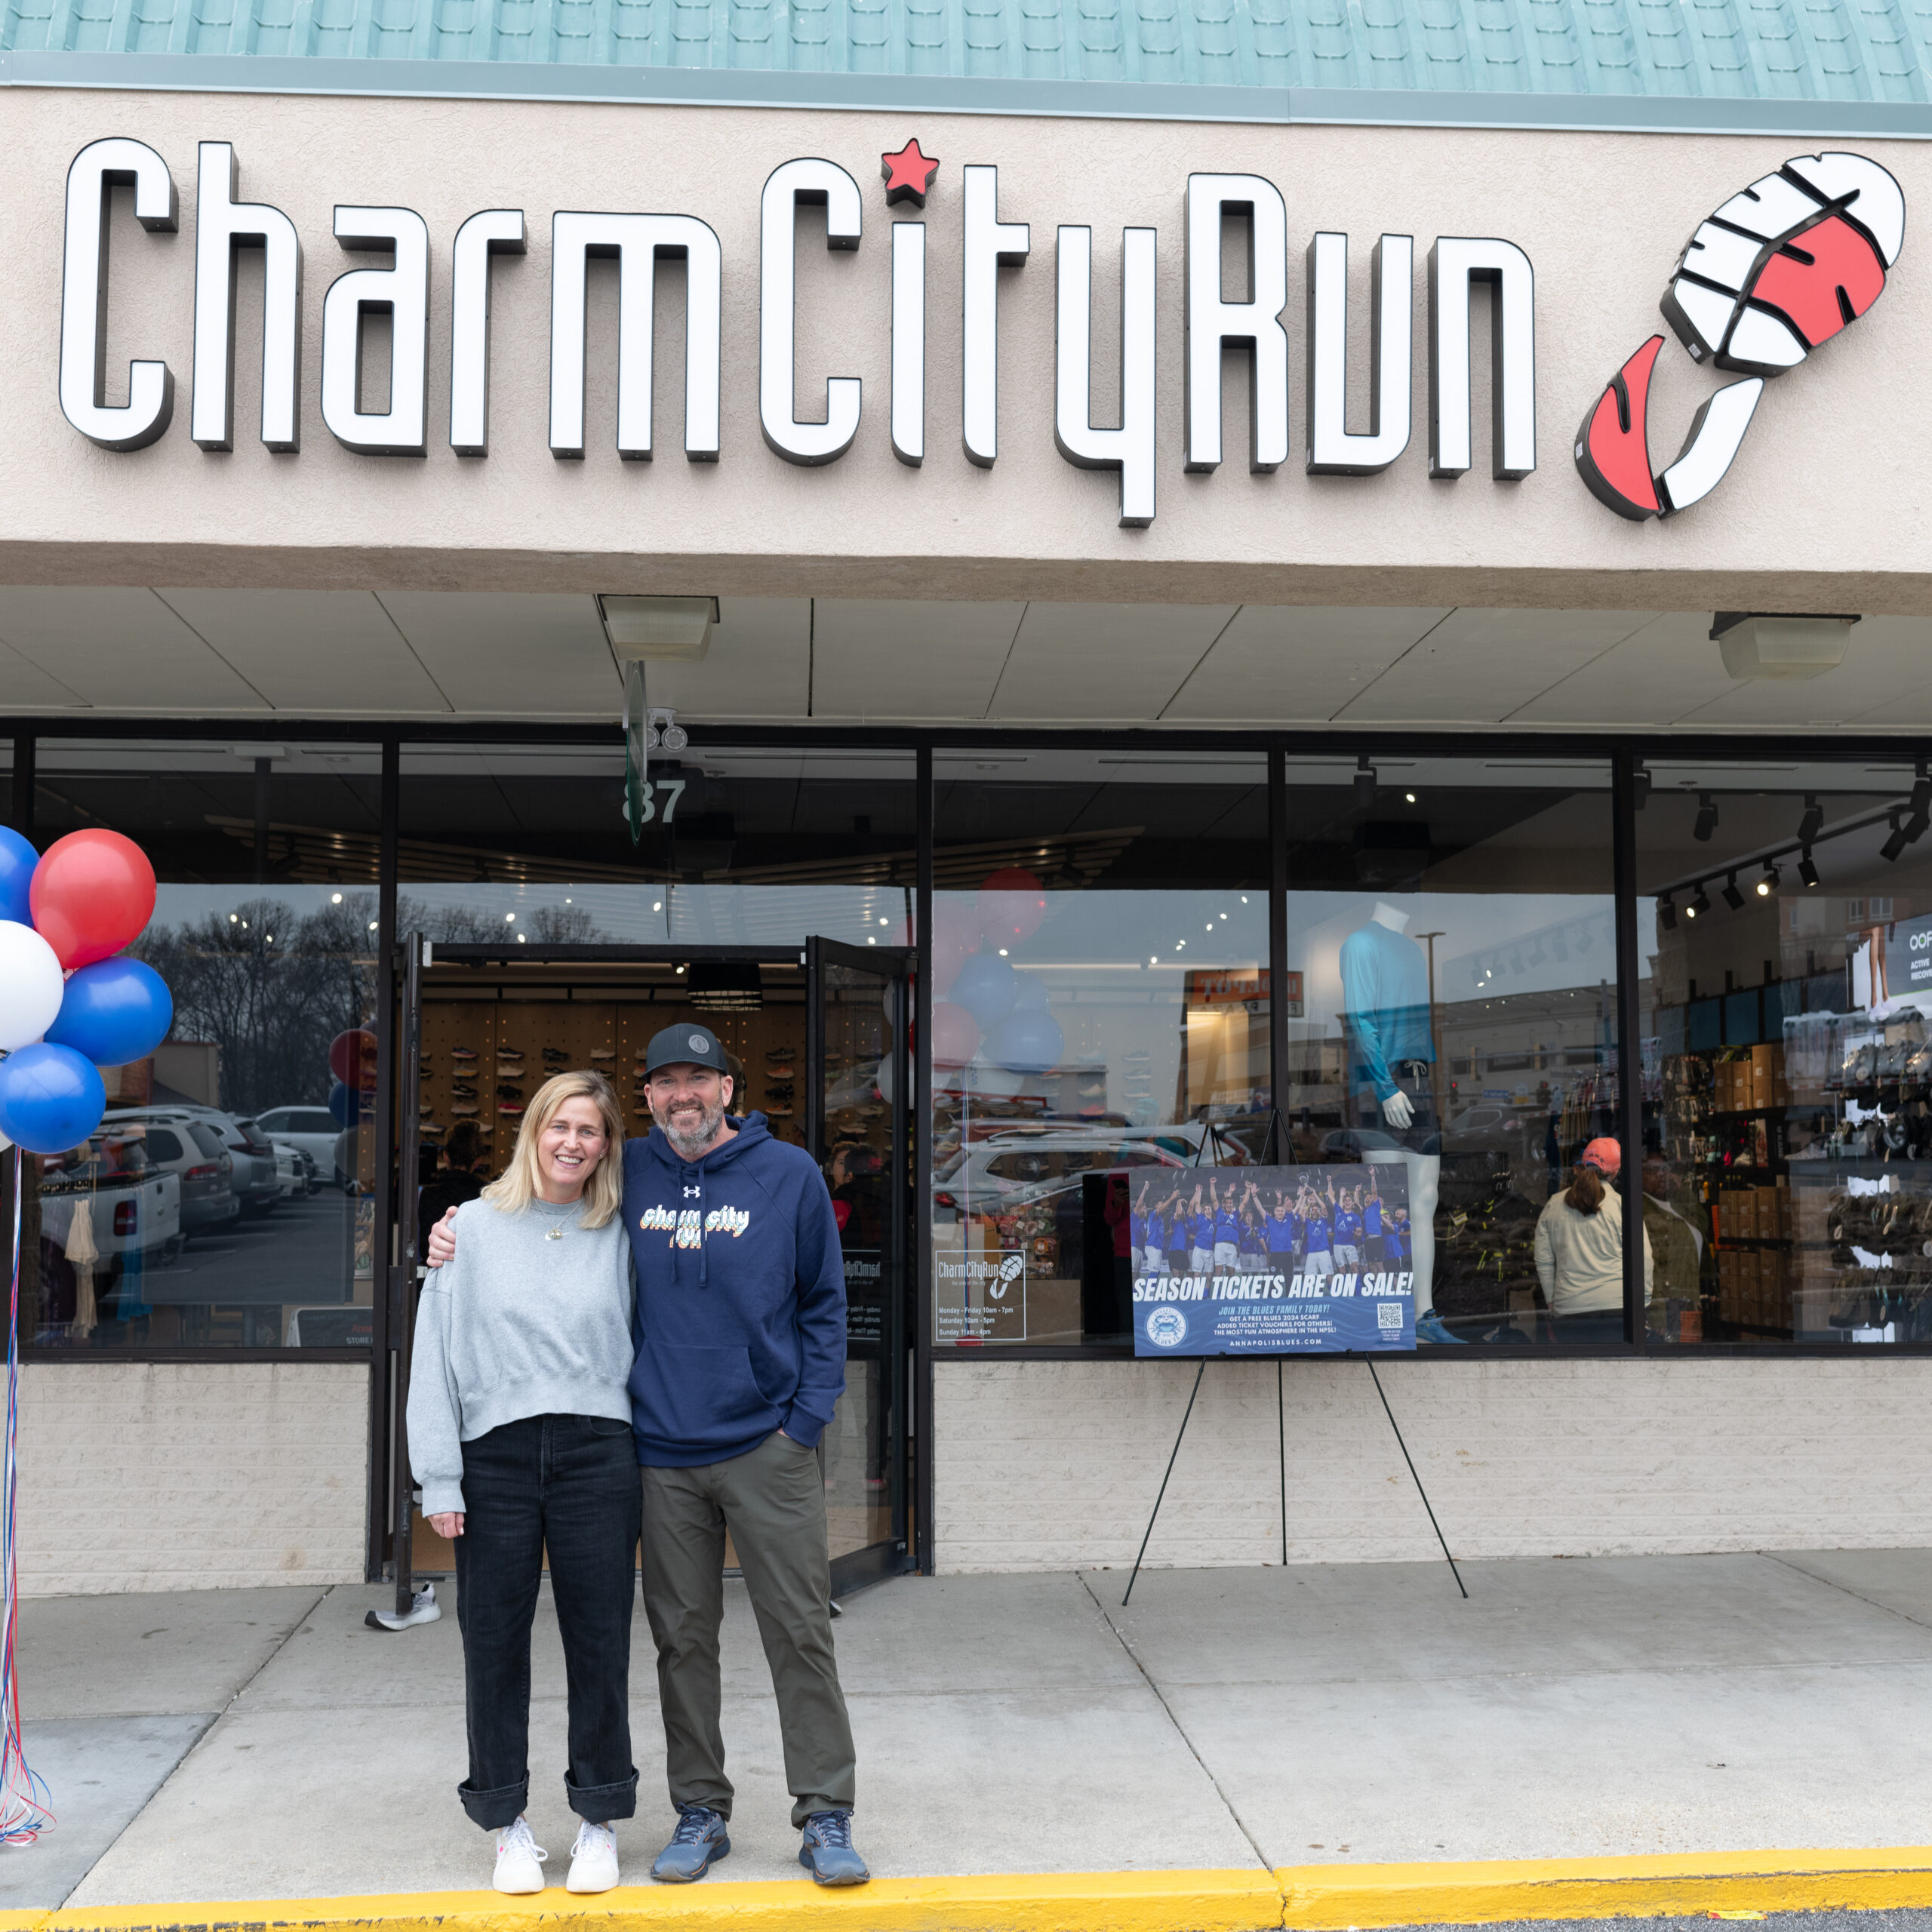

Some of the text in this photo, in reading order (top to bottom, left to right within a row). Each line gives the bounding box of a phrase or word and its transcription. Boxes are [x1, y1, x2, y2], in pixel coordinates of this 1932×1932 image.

[1910, 958, 1930, 970] ACTIVE
[640, 1204, 749, 1237] charm city
[938, 1260, 999, 1280] CharmCityRun
[1133, 1272, 1414, 1302] SEASON TICKETS ARE ON SALE!
[964, 1306, 981, 1315] Friday
[1001, 1306, 1014, 1315] 7pm
[1219, 1304, 1330, 1315] JOIN THE BLUES FAMILY TODAY!
[939, 1317, 963, 1325] Saturday
[939, 1328, 959, 1337] Sunday
